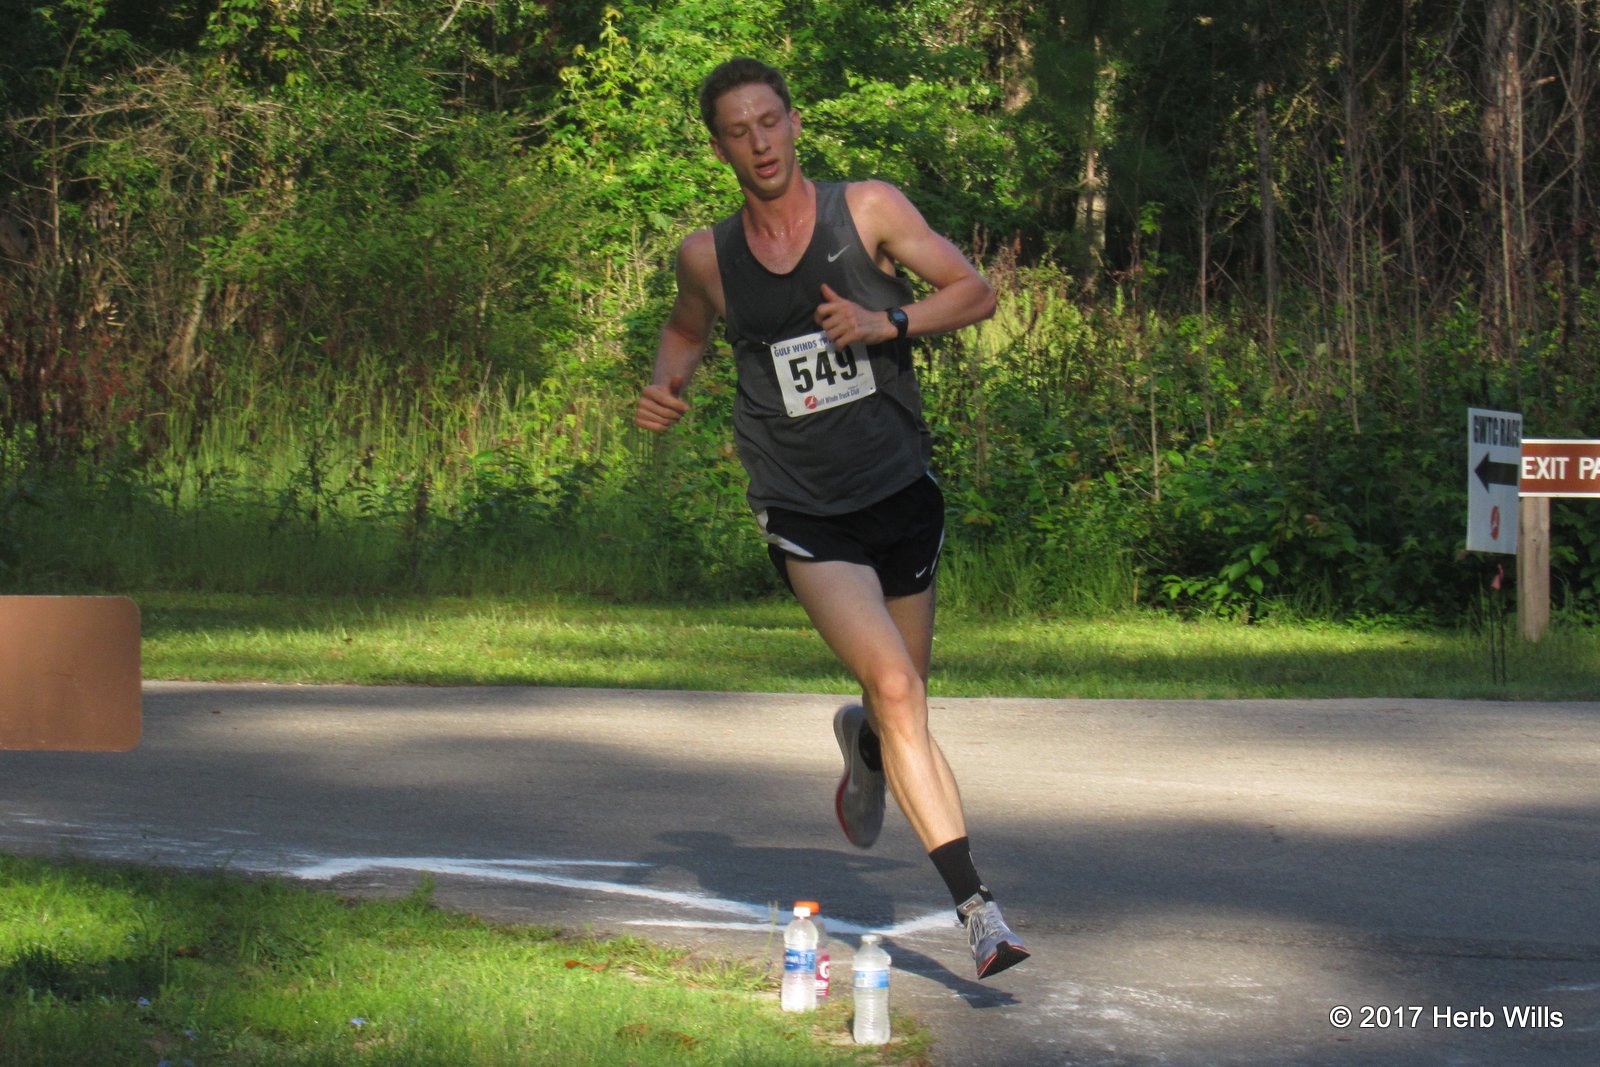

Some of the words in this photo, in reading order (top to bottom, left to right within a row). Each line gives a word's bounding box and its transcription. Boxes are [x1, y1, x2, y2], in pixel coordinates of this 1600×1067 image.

[774, 347, 791, 358] GULF
[792, 339, 818, 353] WINDS
[788, 345, 858, 394] 549
[1521, 456, 1569, 480] EXIT
